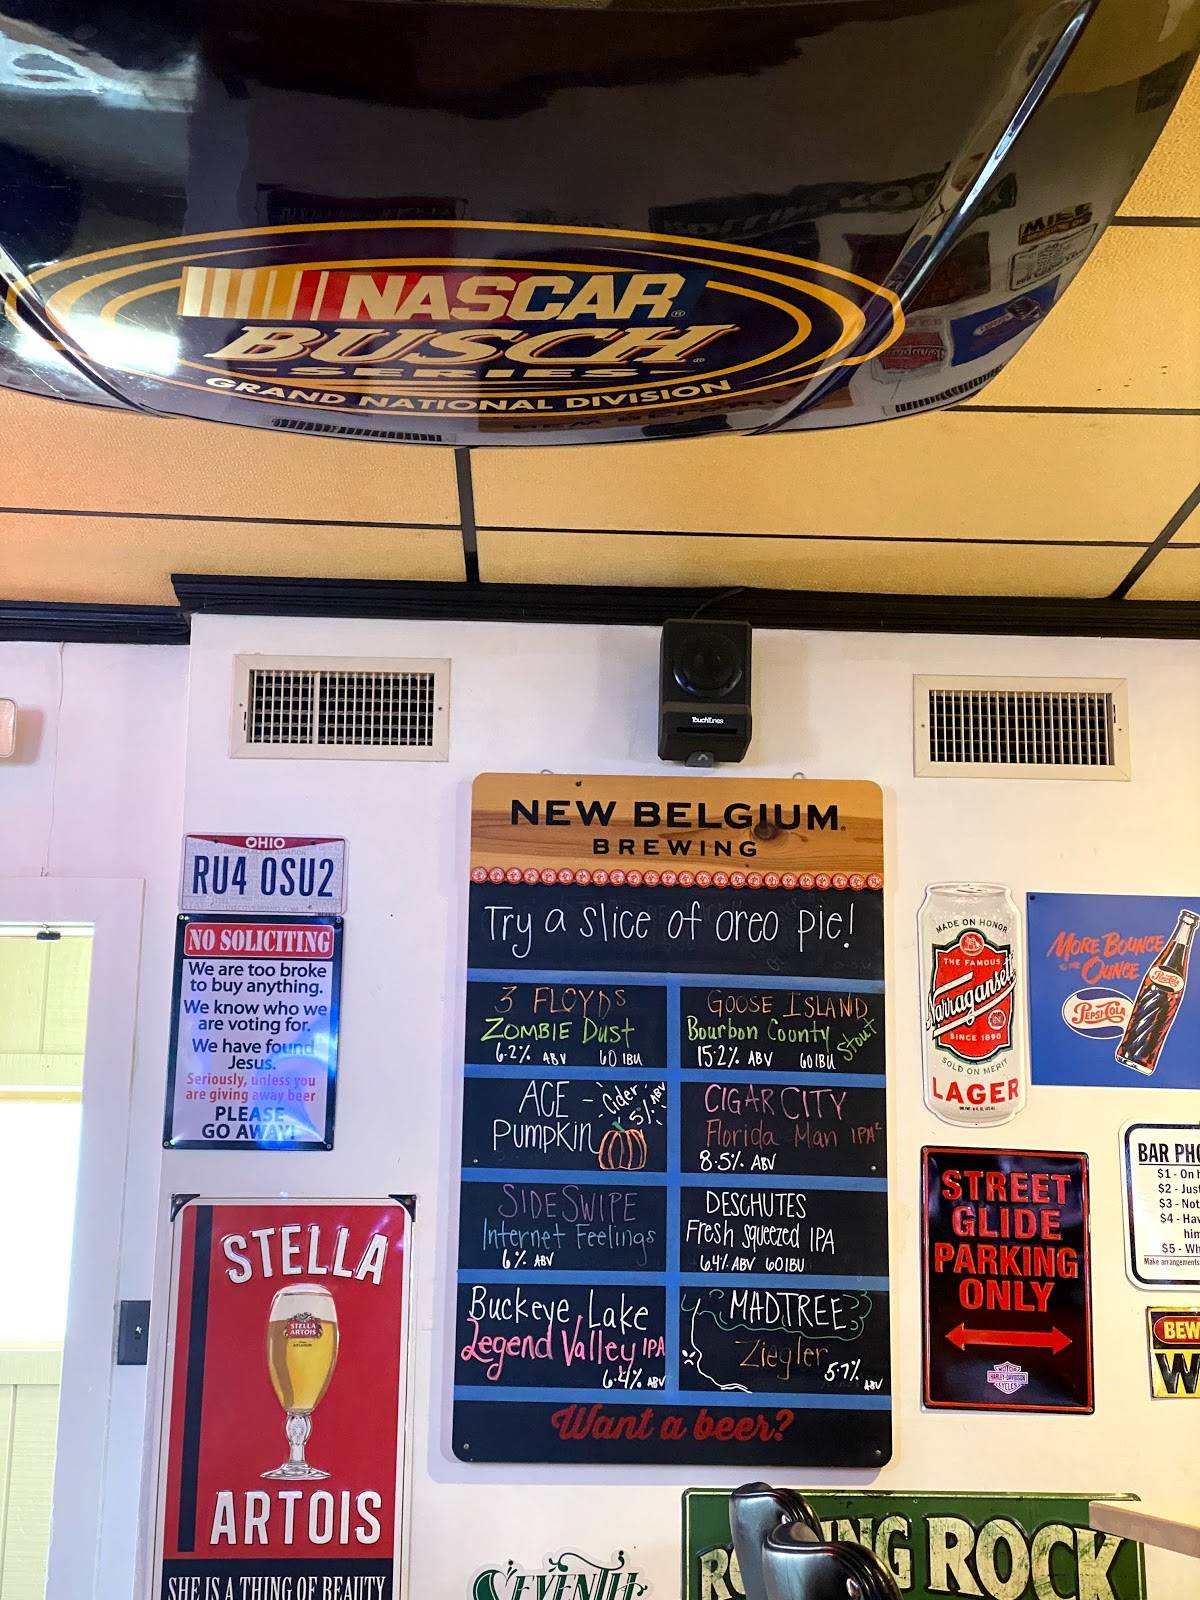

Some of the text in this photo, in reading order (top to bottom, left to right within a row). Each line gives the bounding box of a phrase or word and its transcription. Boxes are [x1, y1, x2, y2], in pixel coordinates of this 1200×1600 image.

[339, 273, 686, 320] NASCAR
[203, 323, 741, 365] BUSCH
[288, 366, 639, 378] SERIES
[205, 377, 731, 411] GRAND NATIONAL DIVISION
[511, 799, 840, 831] NEW BELGIUM
[245, 836, 286, 849] OHIO
[593, 838, 758, 857] BREWING
[192, 855, 247, 895] RU4
[484, 900, 855, 959] Try a slice of oreo pie!
[936, 918, 1009, 934] MADE ON HONOR
[188, 928, 331, 954] NO SOLICITING
[189, 961, 327, 978] We are too broke
[944, 957, 1001, 967] THE FAMOUS
[190, 977, 324, 997] to buy anything.
[926, 952, 1015, 1031] Narragansett
[184, 999, 328, 1016] We know who we
[494, 985, 627, 1020] 3 FLOYDS
[707, 989, 869, 1019] GOOSE ISLAND
[198, 1017, 311, 1035] are voting for.
[480, 1016, 636, 1049] ZOMBIE Dust
[687, 1015, 759, 1041] Bourbon
[767, 1017, 831, 1052] County
[949, 1033, 1002, 1042] SINCE 1890
[192, 1038, 315, 1055] We have found
[542, 1051, 567, 1066] ABV
[622, 1052, 643, 1066] IBU
[227, 1055, 277, 1071] Jesus.
[747, 1051, 774, 1067] ABV
[941, 1056, 1009, 1075] SOLD ON MERIT
[186, 1072, 316, 1089] Seriously, unless you
[932, 1076, 1019, 1105] LAGER
[185, 1088, 316, 1104] are giving away beer
[518, 1080, 639, 1118] ACE Cider
[649, 1081, 666, 1105] ABV
[704, 1083, 848, 1121] CIGAR CITY
[215, 1106, 285, 1122] PLEASE
[202, 1123, 296, 1140] GO AWAY!
[493, 1119, 601, 1154] Pumpkin
[706, 1118, 838, 1150] Florida Man
[750, 1152, 777, 1171] ABV
[1138, 1143, 1170, 1162] BAR
[1157, 1168, 1194, 1179] $1 On
[941, 1169, 1072, 1205] STREET
[1158, 1183, 1172, 1194] $2
[706, 1190, 807, 1219] DESCHUTES
[1159, 1198, 1173, 1209] $3
[952, 1205, 1062, 1241] GLIDE
[1160, 1212, 1174, 1224] $4
[482, 1217, 657, 1267] Internet Feelings
[686, 1219, 835, 1255] Fresh squeezed IPA
[1161, 1242, 1176, 1254] $5
[221, 1224, 390, 1286] STELLA
[534, 1251, 554, 1267] ABV
[731, 1256, 756, 1271] ABV
[934, 1242, 1079, 1279] PARKING
[1144, 1257, 1160, 1266] Make
[959, 1278, 1055, 1312] ONLY
[469, 1285, 649, 1336] Buckeye Lake
[461, 1314, 666, 1381] Legend Valley IPA
[735, 1335, 829, 1381] Ziegler
[647, 1375, 666, 1389] ABV
[864, 1377, 884, 1391] ABV
[551, 1403, 795, 1442] Want a beer?
[209, 1490, 382, 1545] ARTOIS
[926, 1515, 1127, 1600] ROCK
[168, 1576, 387, 1600] SHE IS A THING OF BEAUTY
